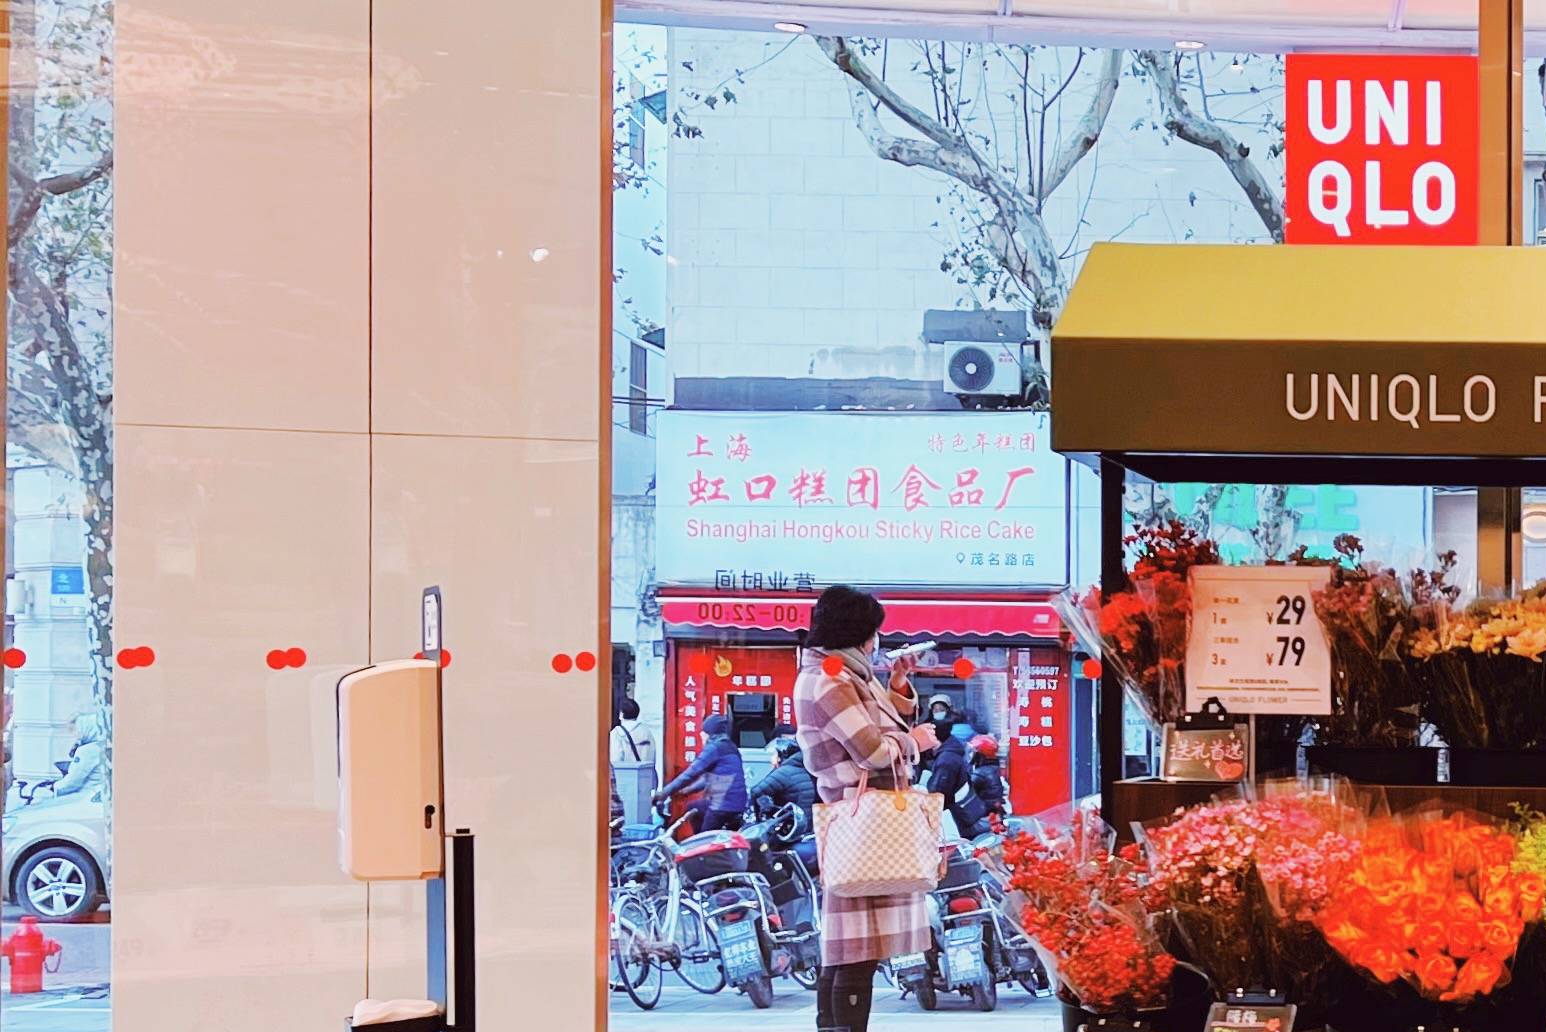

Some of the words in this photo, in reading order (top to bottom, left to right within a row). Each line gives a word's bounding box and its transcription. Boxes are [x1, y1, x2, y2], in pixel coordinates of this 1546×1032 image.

[1307, 79, 1442, 146] UNI
[1307, 159, 1456, 238] QLO
[1285, 373, 1497, 429] UNIQLO
[687, 432, 752, 463] 上海
[687, 464, 1036, 512] 虹口糕团食品厂
[686, 519, 777, 542] Shanghai
[783, 519, 869, 542] Hongkou
[875, 519, 934, 543] Sticky
[940, 521, 981, 540] Rice
[987, 520, 1035, 540] Cake
[970, 552, 1036, 567] 茂名路店
